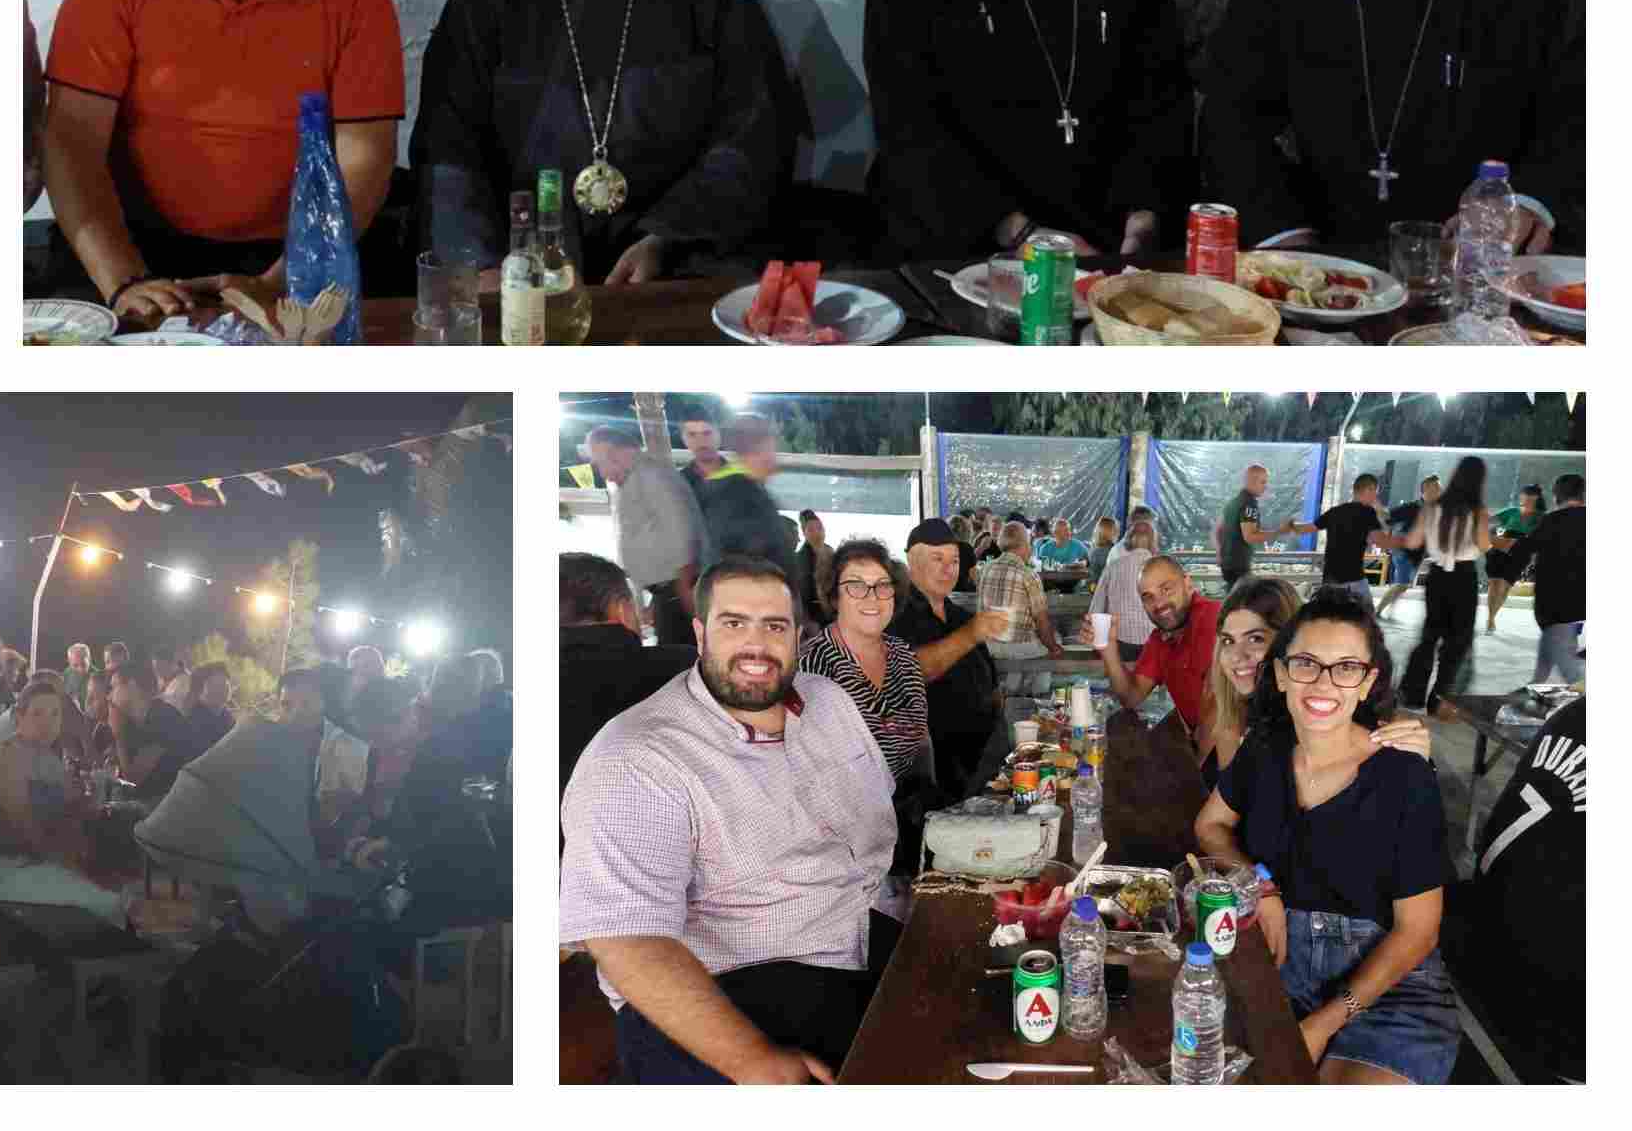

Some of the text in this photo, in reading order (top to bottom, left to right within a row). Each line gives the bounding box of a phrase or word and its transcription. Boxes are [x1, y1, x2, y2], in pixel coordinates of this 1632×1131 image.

[1480, 782, 1553, 875] 7
[1215, 911, 1234, 934] A
[1025, 993, 1053, 1017] A
